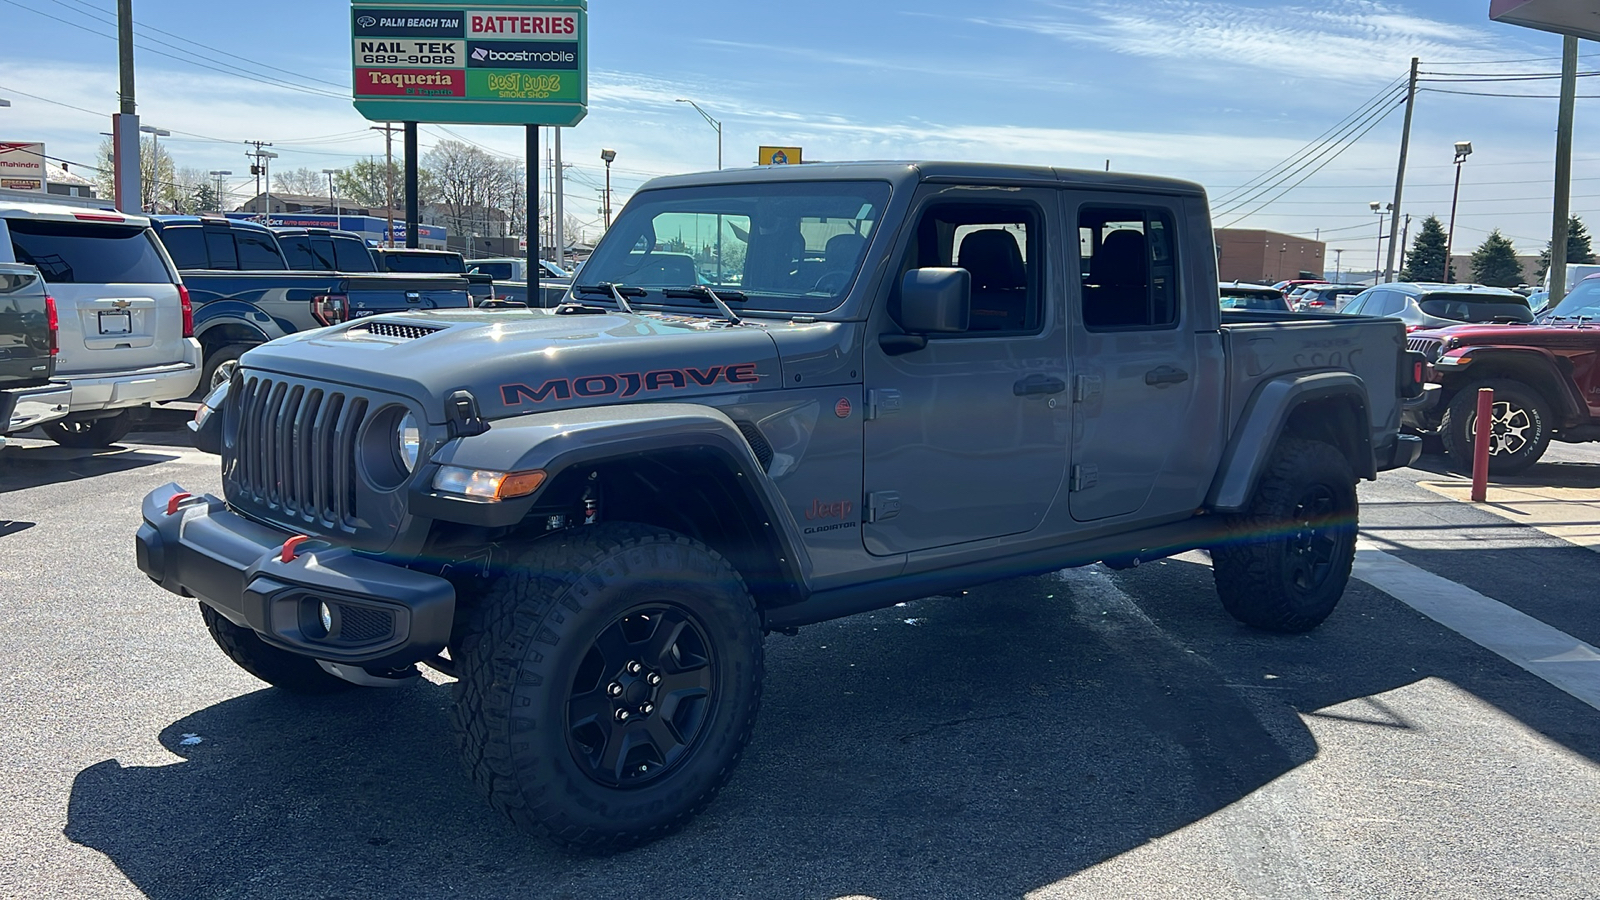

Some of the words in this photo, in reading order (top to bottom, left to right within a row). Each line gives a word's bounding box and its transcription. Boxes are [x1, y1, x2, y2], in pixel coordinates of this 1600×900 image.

[379, 18, 405, 27] PALM
[407, 18, 438, 28] BEACH
[441, 19, 459, 28] TAN
[472, 16, 575, 34] BATTERIES
[361, 42, 406, 53] NAIL
[414, 42, 456, 54] TEK
[363, 55, 455, 64] 689-9088
[489, 50, 574, 62] boostmobile
[500, 363, 759, 406] MOJAVE
[804, 498, 853, 520] Jeep
[803, 521, 856, 534] GLADIATOR
